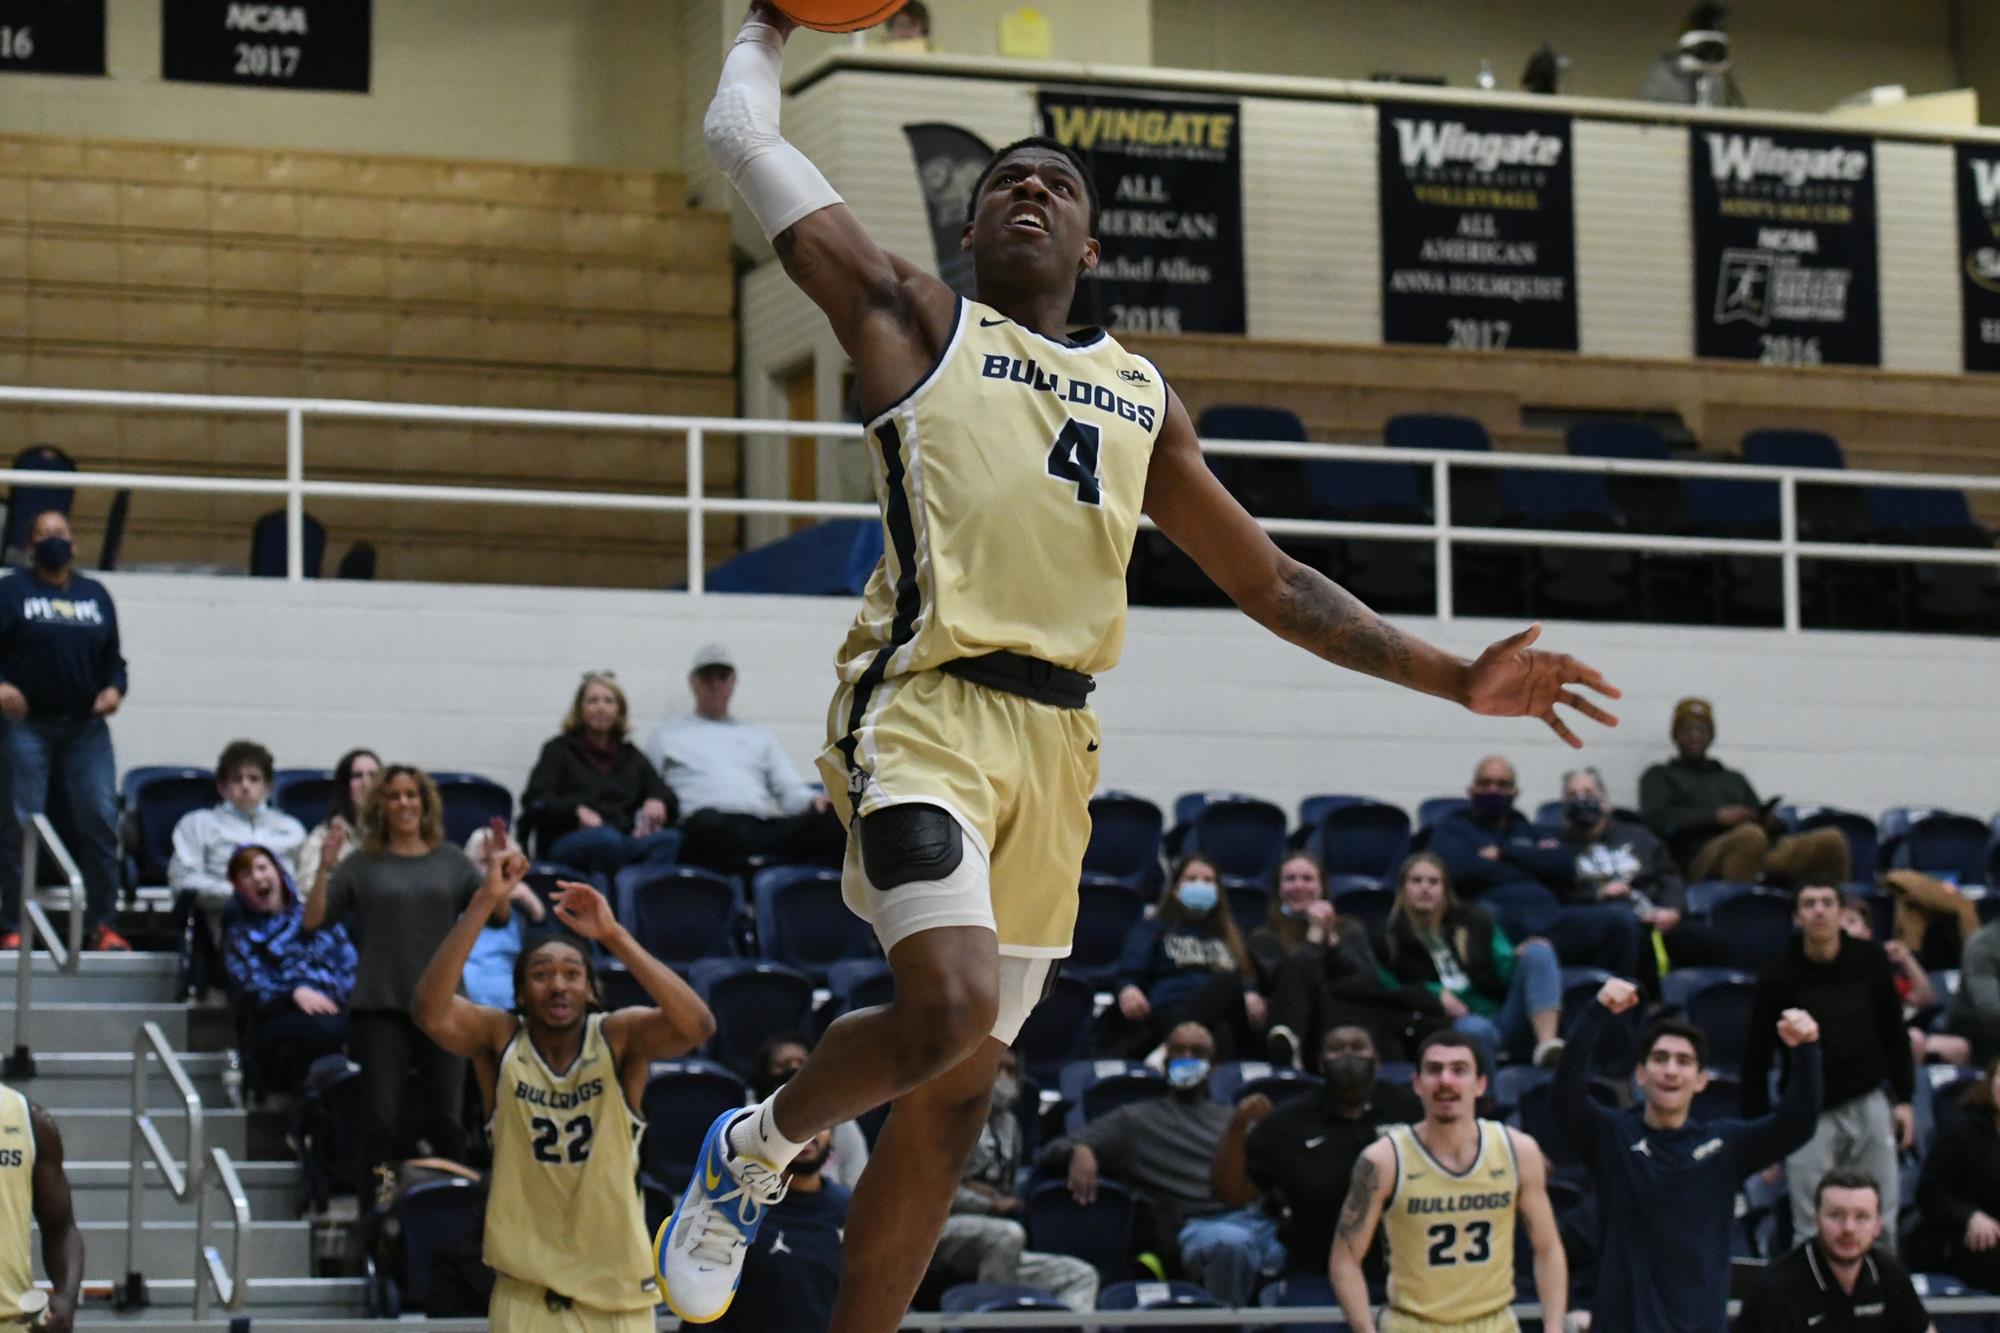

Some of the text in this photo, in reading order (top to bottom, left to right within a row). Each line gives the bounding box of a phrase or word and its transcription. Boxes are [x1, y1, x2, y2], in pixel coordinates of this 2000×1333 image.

[233, 42, 301, 78] 2017
[1048, 104, 1234, 150] WINGATE
[1393, 117, 1563, 172] Wingate
[1704, 132, 1868, 187] Wingate
[1114, 174, 1170, 204] ALL
[1419, 238, 1538, 266] AMERICAN
[982, 353, 1155, 434] BULLDOGS
[1046, 416, 1102, 506] 4
[515, 1079, 604, 1110] BULLDOGS
[531, 1115, 593, 1164] 22
[1407, 1191, 1511, 1215] BULLDOGS
[1427, 1220, 1491, 1266] 23
